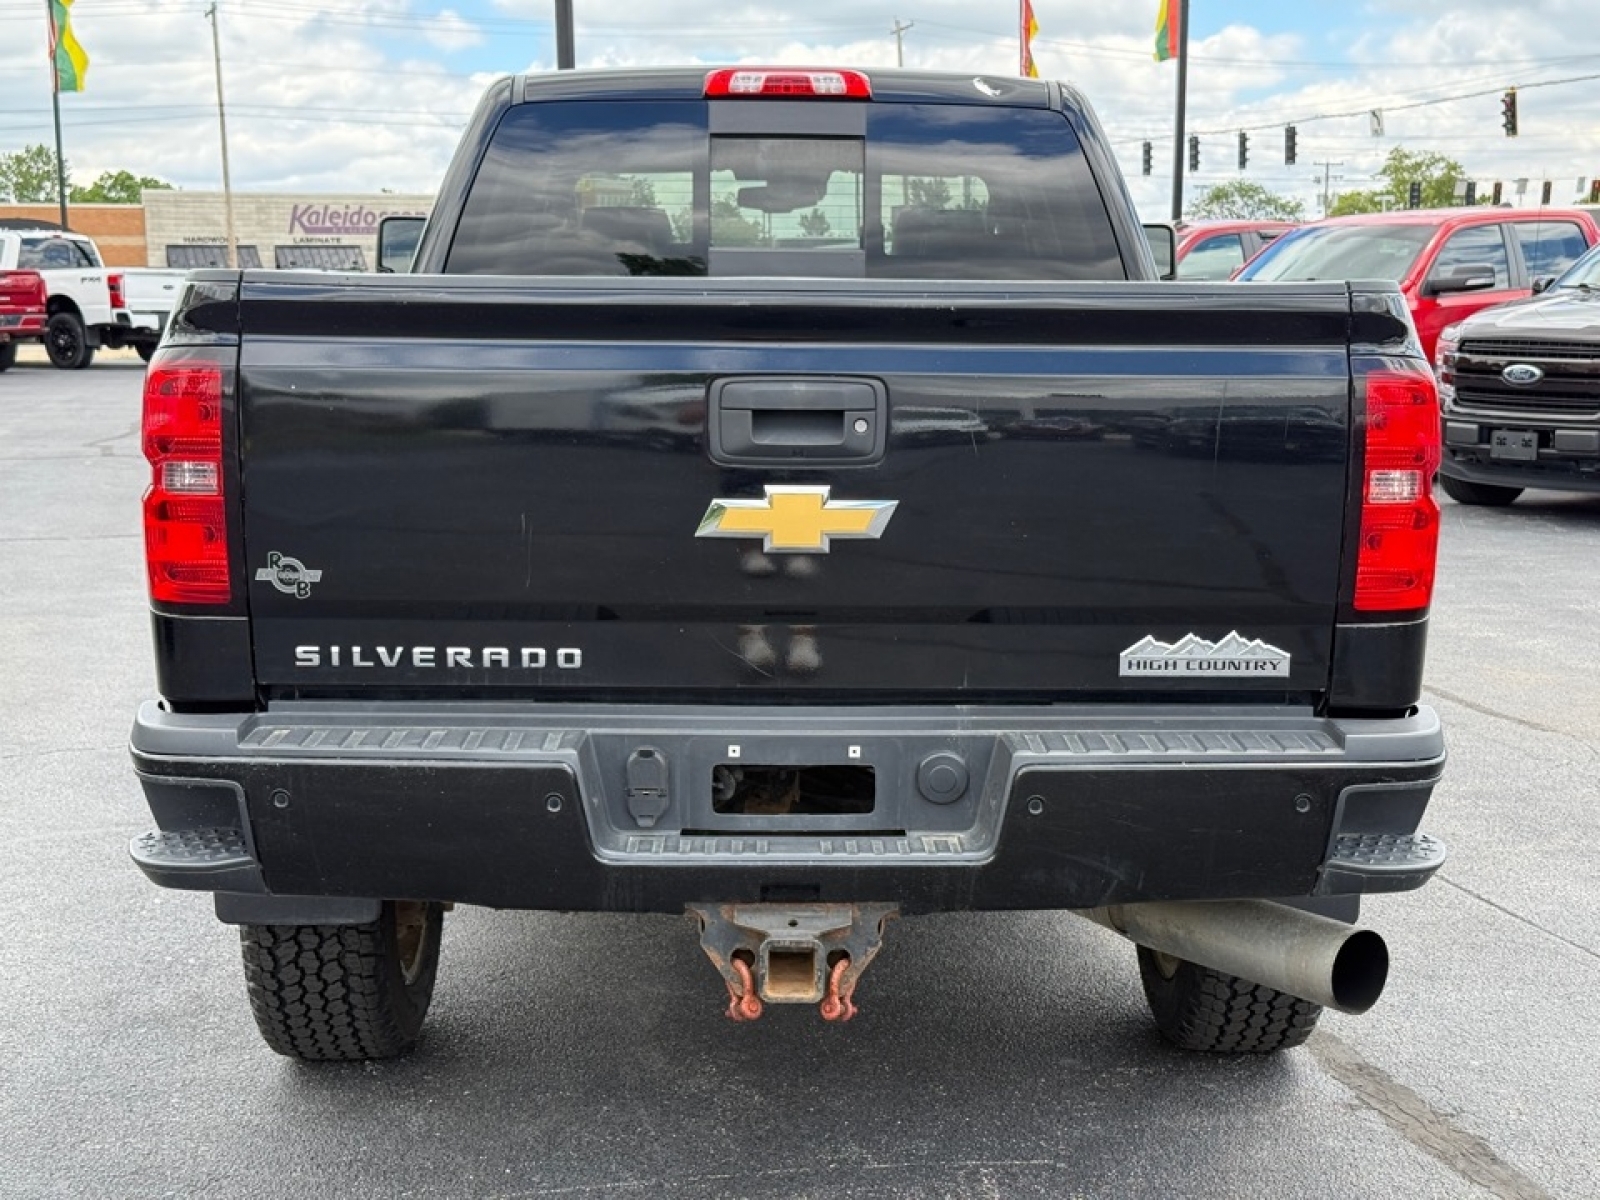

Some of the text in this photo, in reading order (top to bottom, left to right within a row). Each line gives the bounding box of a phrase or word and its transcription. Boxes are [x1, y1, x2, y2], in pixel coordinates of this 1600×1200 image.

[289, 204, 427, 234] Kaleido
[183, 235, 240, 243] HARDWOD
[293, 236, 342, 244] LAMINATE
[294, 645, 583, 669] SILVERADO
[1127, 659, 1281, 671] HIGH COUNTRY
